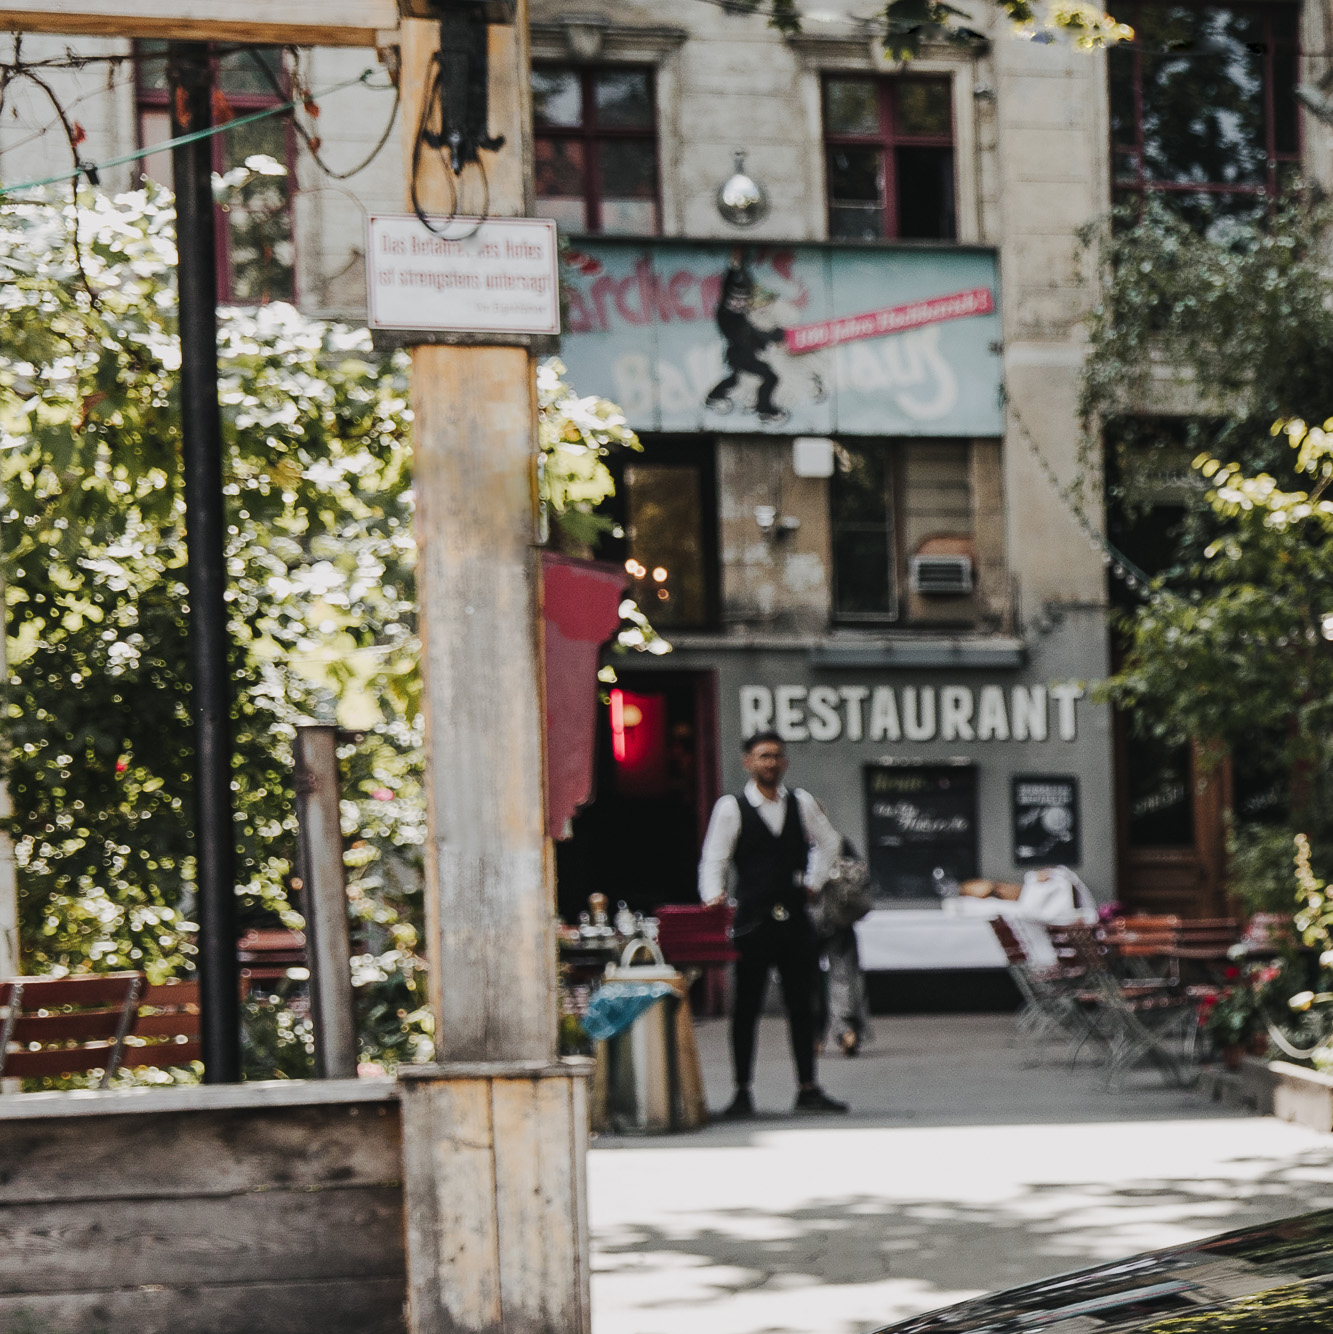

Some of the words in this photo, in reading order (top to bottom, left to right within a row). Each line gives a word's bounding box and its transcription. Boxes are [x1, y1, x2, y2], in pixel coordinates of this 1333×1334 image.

[382, 234, 406, 256] Das
[412, 236, 477, 258] Befahre
[478, 239, 500, 260] es
[399, 270, 480, 292] strengstens
[485, 272, 552, 296] untersagt
[739, 684, 1084, 742] RESTAURANT
